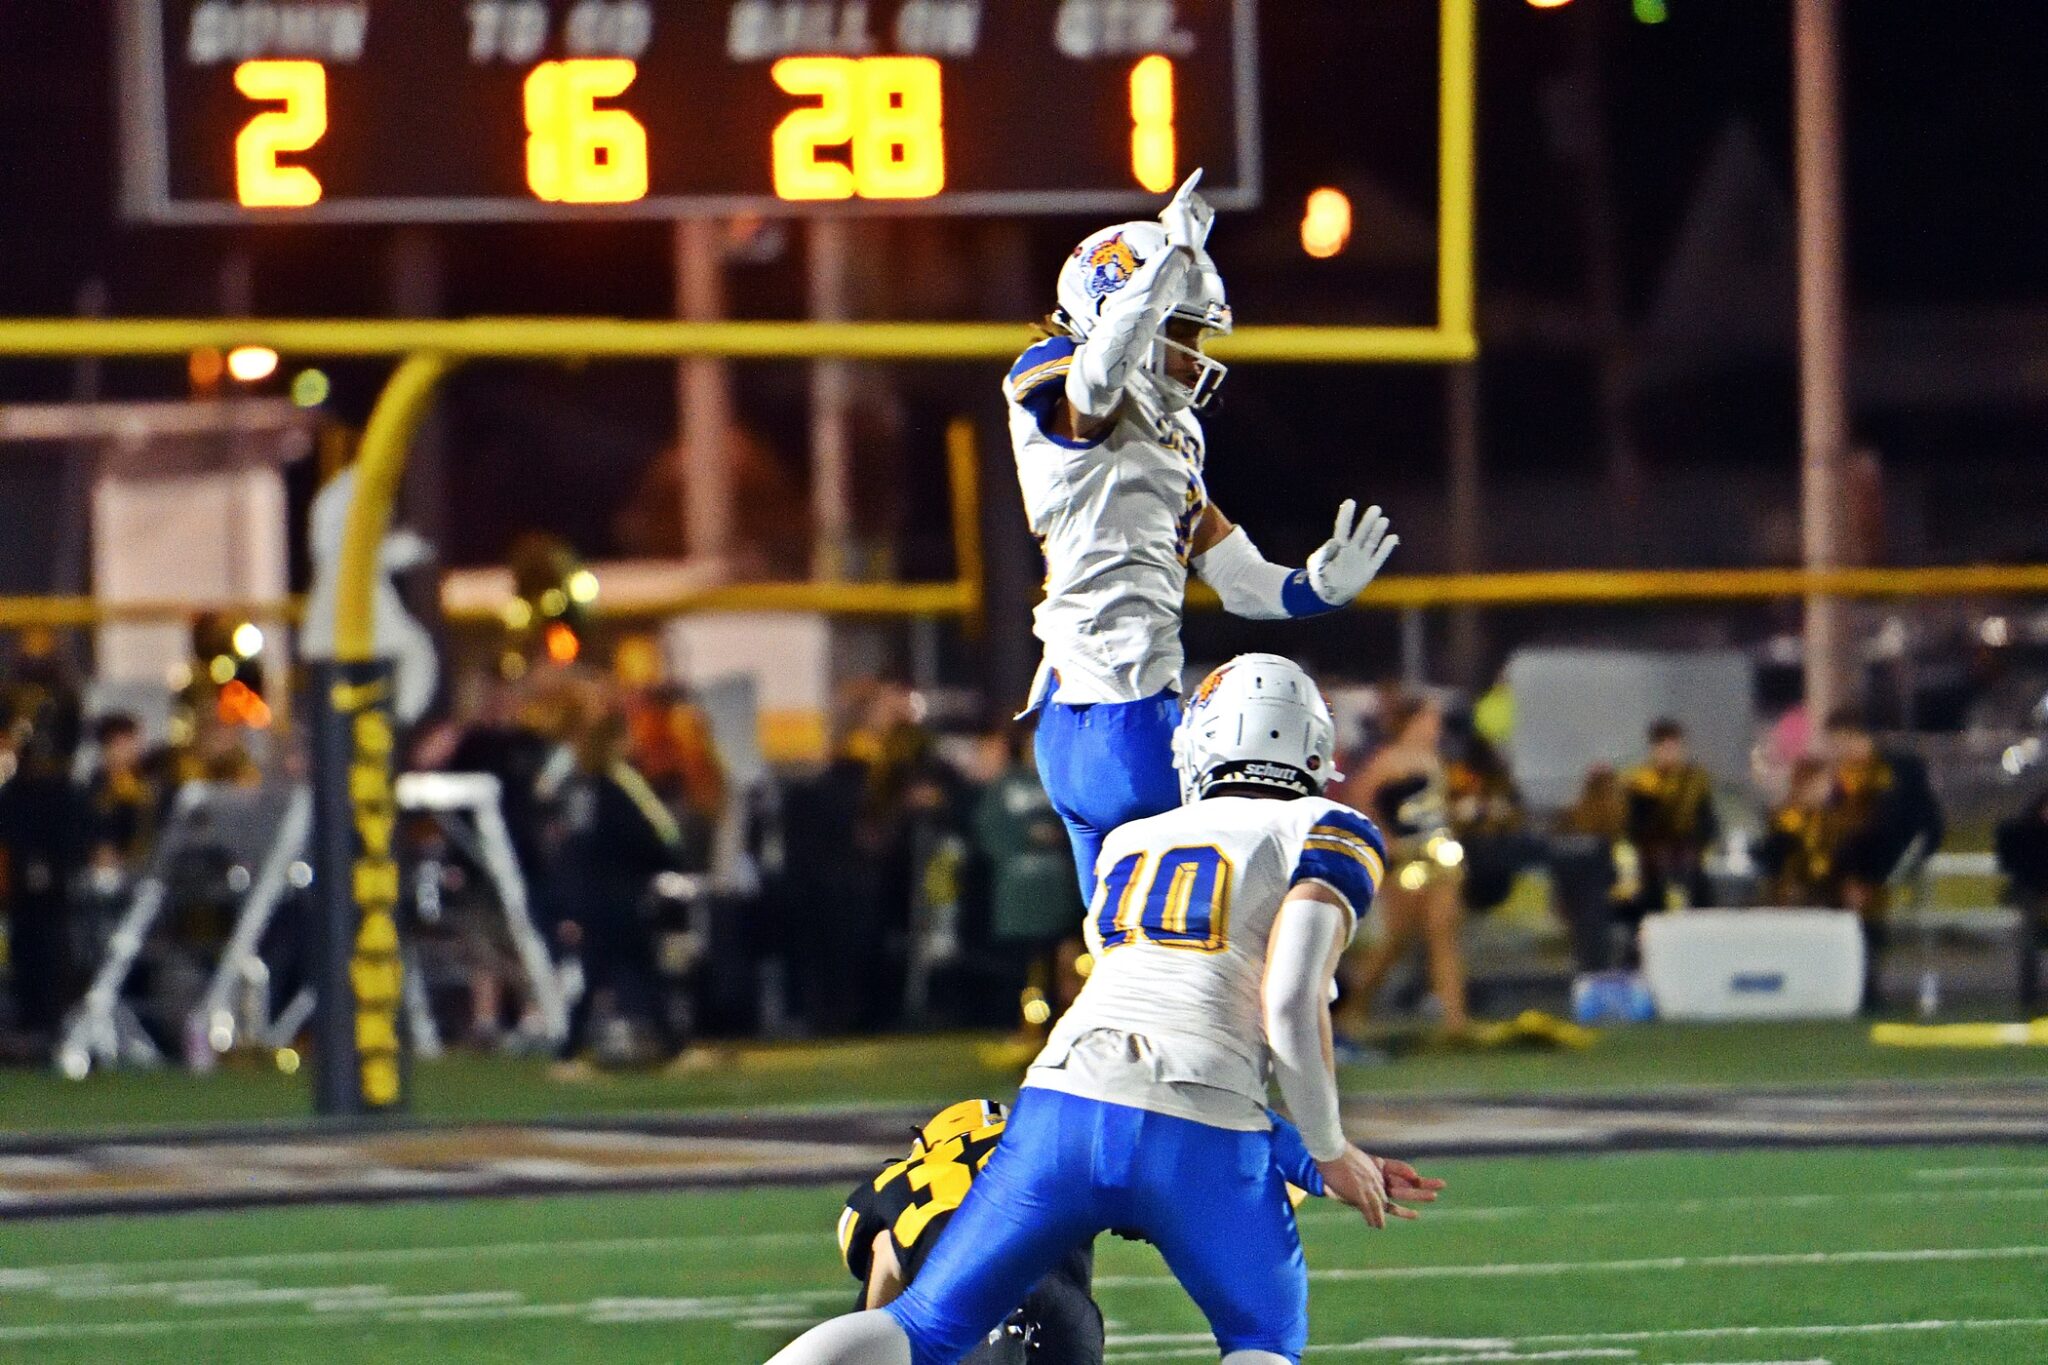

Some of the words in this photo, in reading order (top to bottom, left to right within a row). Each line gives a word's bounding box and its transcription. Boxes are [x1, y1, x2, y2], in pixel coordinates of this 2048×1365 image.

[235, 60, 327, 206] 2
[524, 59, 648, 203] 16
[771, 57, 944, 200] 28
[1130, 55, 1175, 192] 1
[1095, 843, 1234, 956] 10
